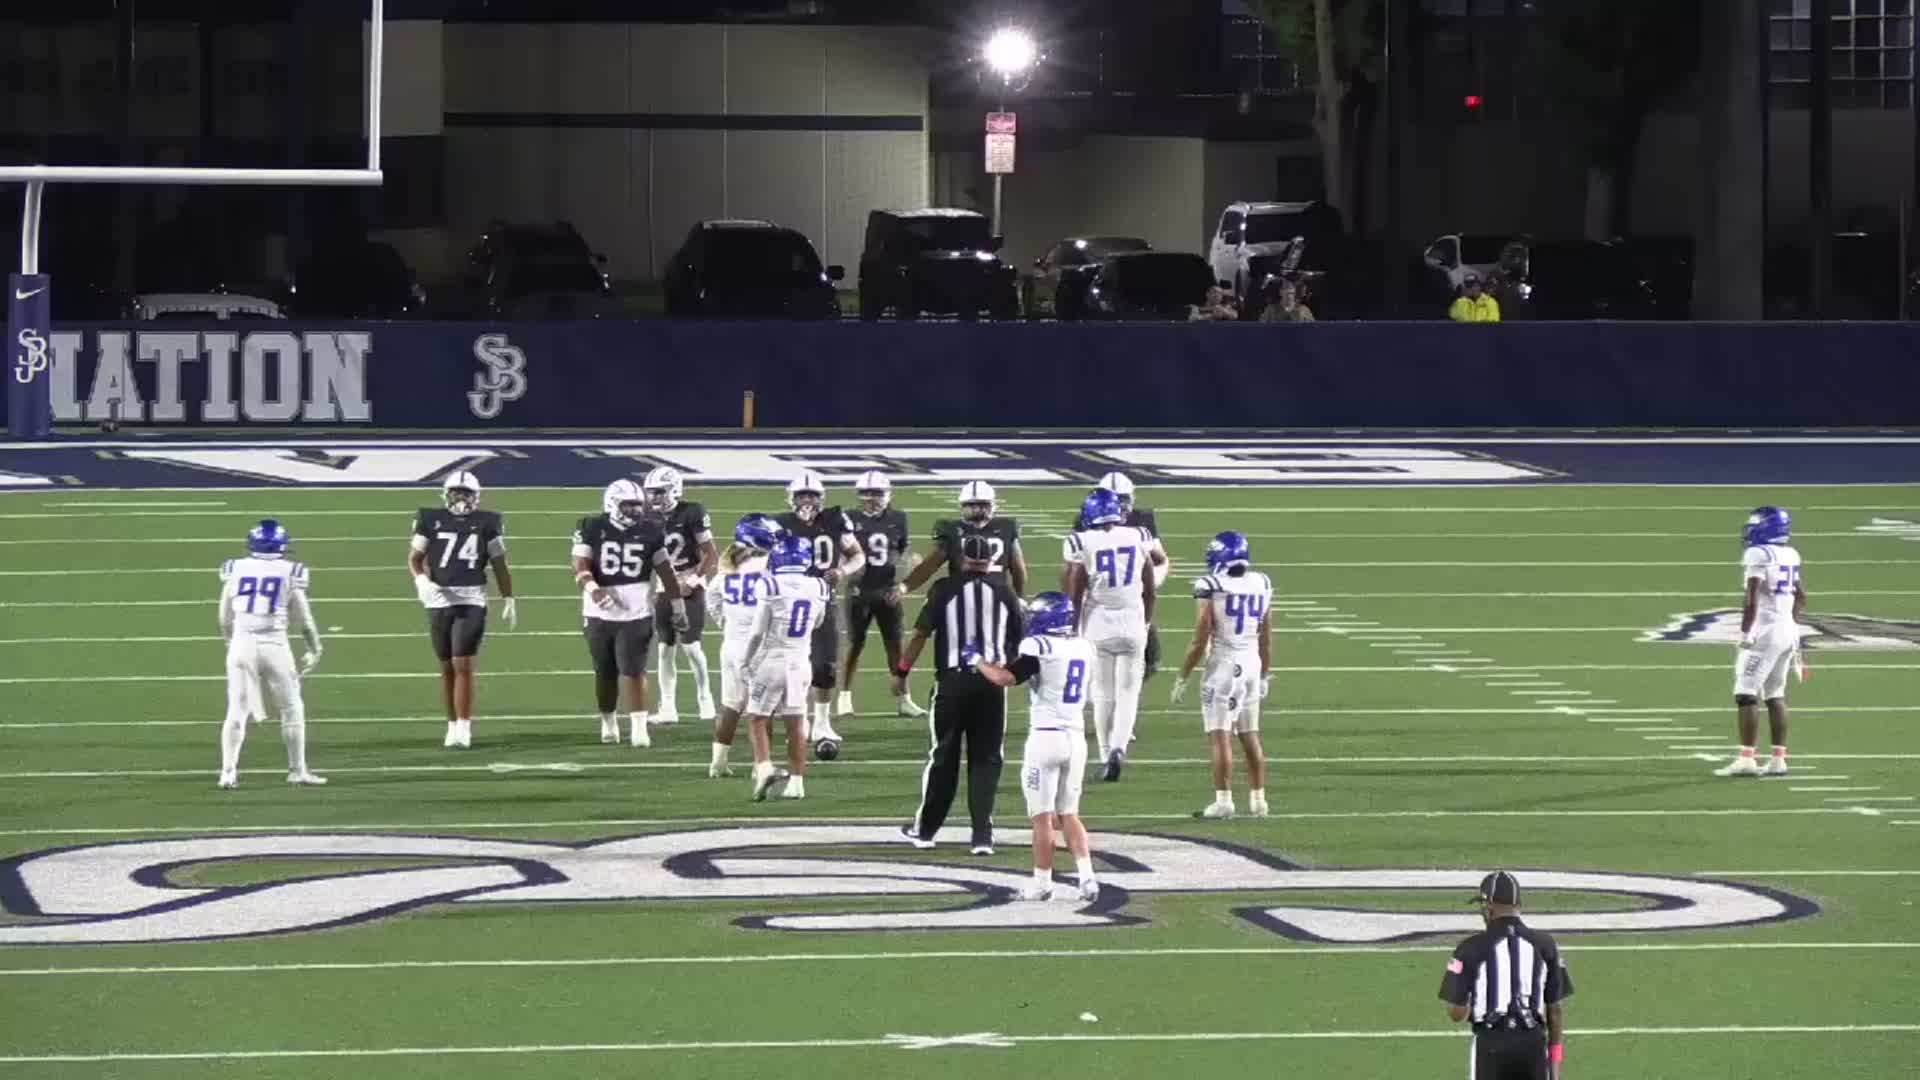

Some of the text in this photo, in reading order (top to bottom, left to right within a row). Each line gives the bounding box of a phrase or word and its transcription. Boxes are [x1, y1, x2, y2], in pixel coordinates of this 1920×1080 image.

[437, 531, 479, 569] 74
[600, 541, 645, 577] 65
[664, 532, 689, 566] 2
[814, 535, 834, 569] 0
[868, 533, 889, 566] 9
[1096, 546, 1136, 588] 97
[238, 576, 283, 614] 99
[787, 600, 812, 638] 0
[1225, 594, 1264, 635] 44
[1063, 659, 1086, 704] 8
